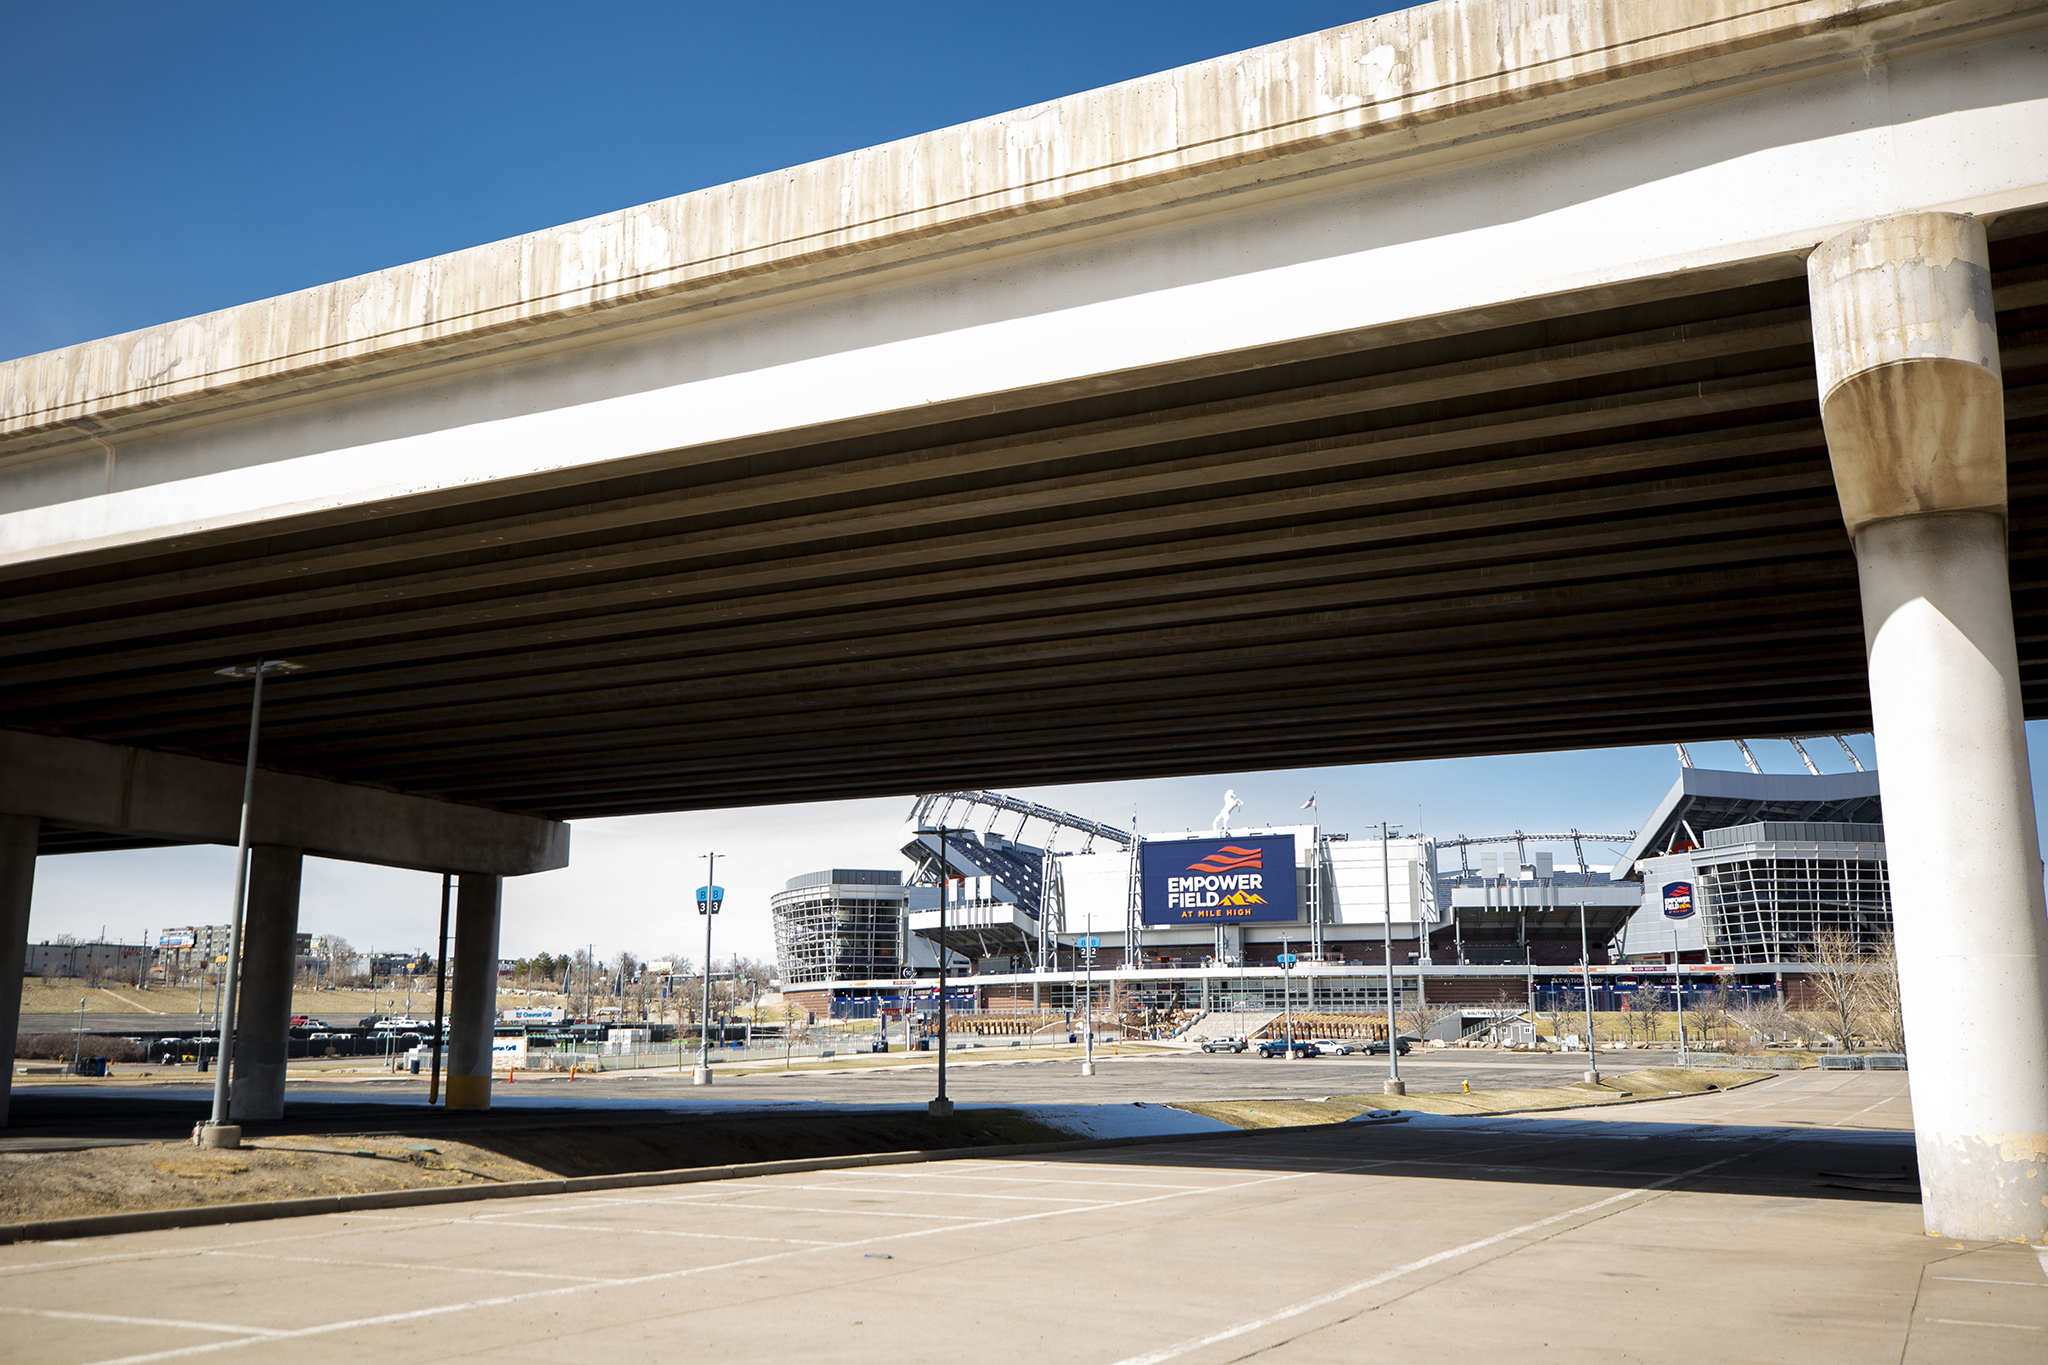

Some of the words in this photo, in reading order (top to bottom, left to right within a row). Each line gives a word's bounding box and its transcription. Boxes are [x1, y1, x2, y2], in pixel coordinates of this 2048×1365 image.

[1168, 874, 1263, 893] EMPOWER
[701, 890, 706, 900] B
[713, 890, 719, 899] B
[1168, 892, 1220, 909] FIELD
[1664, 896, 1691, 904] EMPOWER
[700, 902, 706, 912] 3
[713, 902, 718, 911] 3
[1181, 910, 1193, 918] AT
[1198, 909, 1222, 917] MILE
[1226, 908, 1252, 916] HIGH
